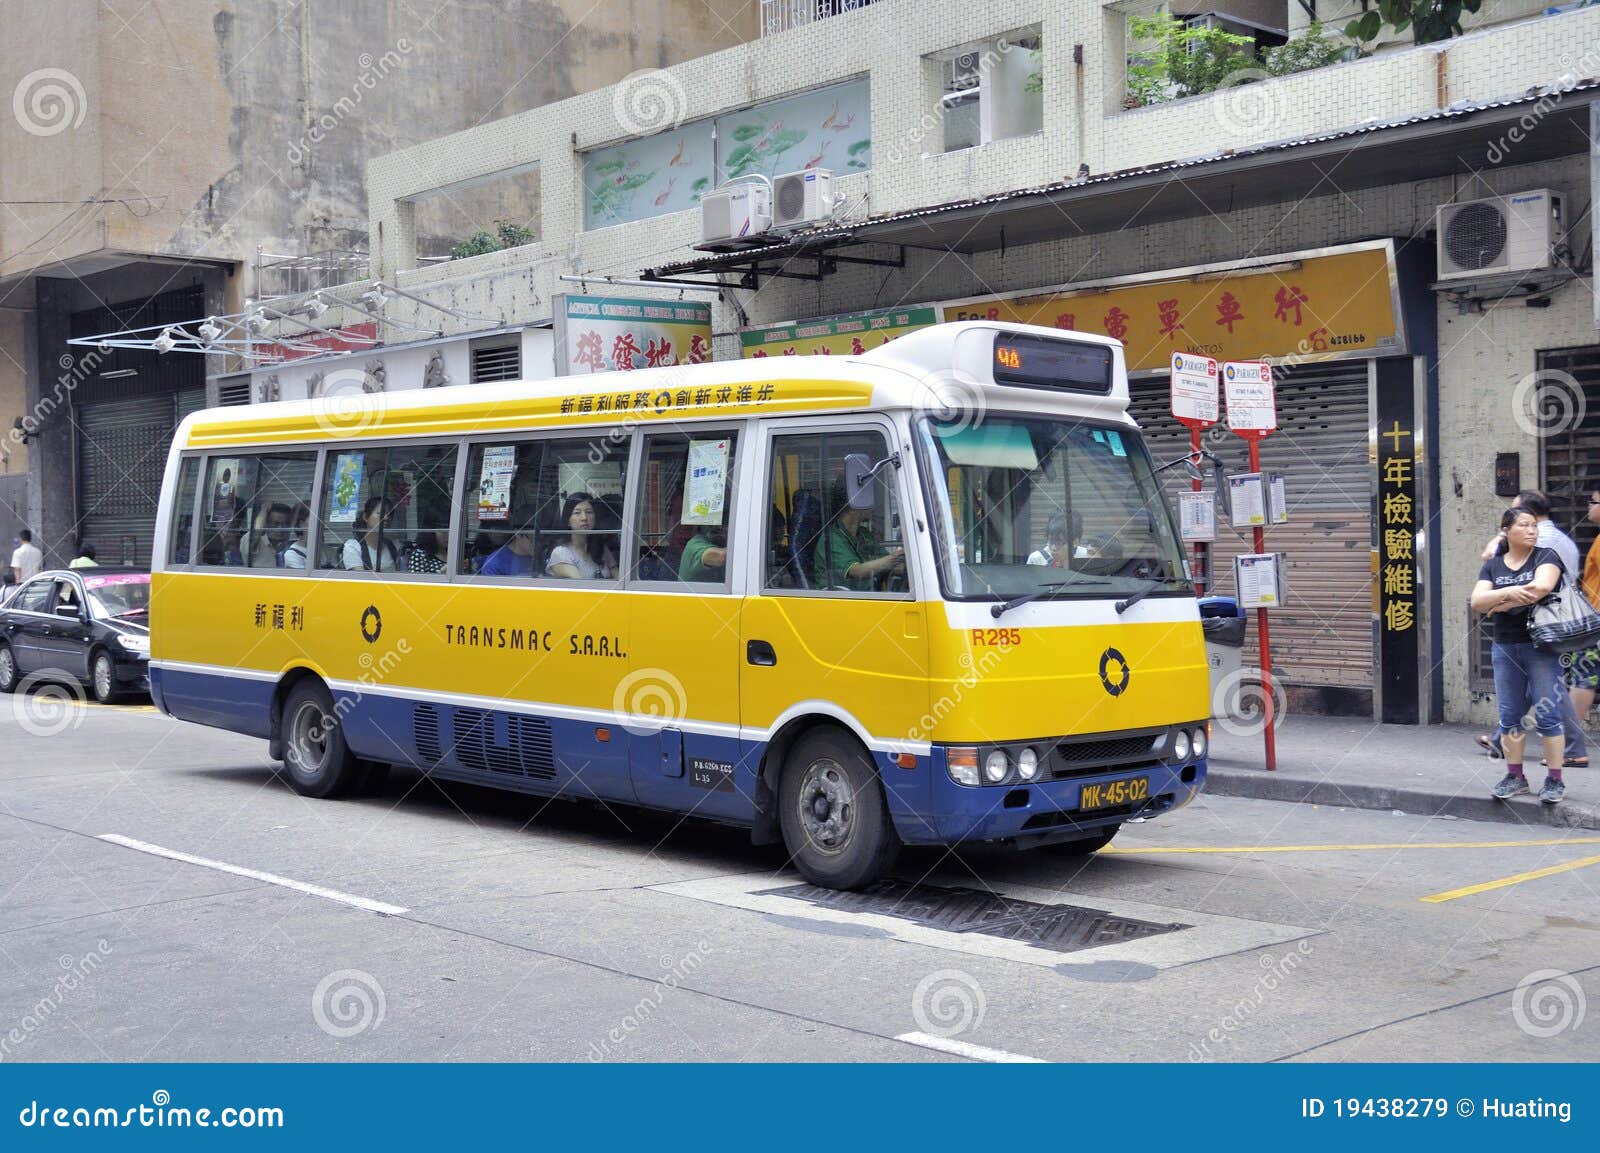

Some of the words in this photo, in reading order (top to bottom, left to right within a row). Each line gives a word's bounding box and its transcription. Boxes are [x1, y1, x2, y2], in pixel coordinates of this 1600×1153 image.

[1383, 420, 1414, 632] 十年檢驗維修
[255, 603, 304, 631] 新福利
[446, 624, 552, 652] TRANSMAC
[570, 634, 627, 658] S.A.R.L.
[972, 628, 1021, 646] R285
[1082, 778, 1149, 809] MK-45-02
